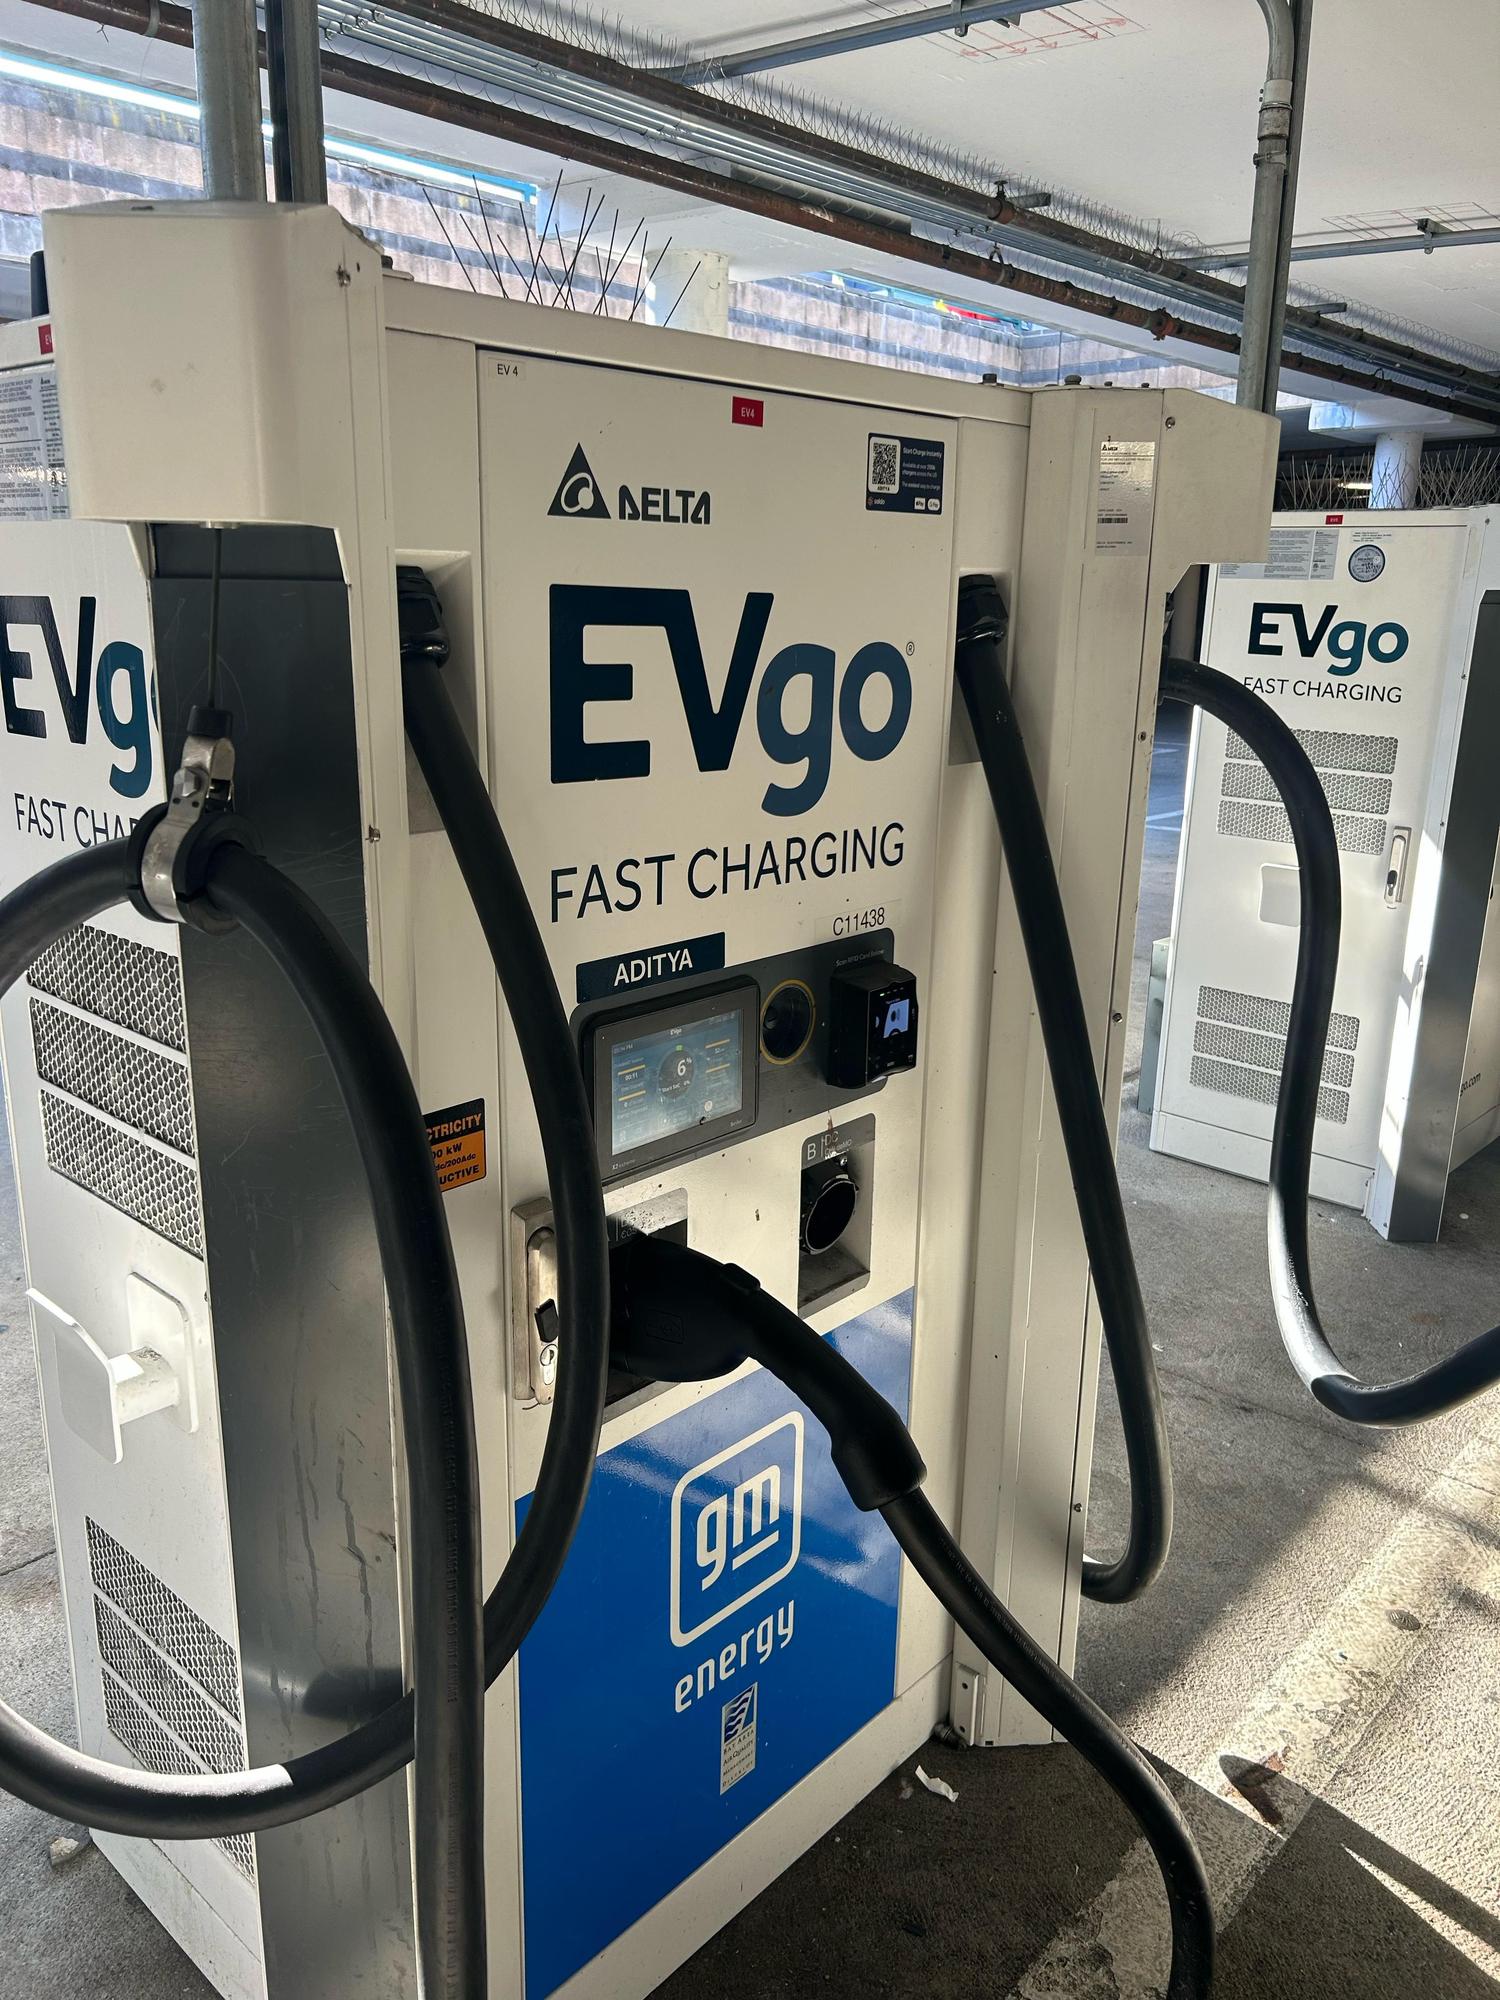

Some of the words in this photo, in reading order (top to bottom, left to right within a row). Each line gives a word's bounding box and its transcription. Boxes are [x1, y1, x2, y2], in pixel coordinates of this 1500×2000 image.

[497, 364, 511, 375] EV
[512, 366, 518, 376] 4
[741, 407, 755, 418] EV4
[913, 448, 926, 457] Charge
[926, 450, 943, 459] Instantly
[619, 484, 710, 525] DELTA
[1248, 602, 1409, 676] EVgo
[0, 596, 159, 798] EVg
[550, 584, 912, 816] EVgo
[1293, 680, 1402, 703] CHARGING
[14, 793, 67, 842] FAST
[74, 806, 142, 848] CHA
[551, 854, 675, 922] FAST
[688, 822, 904, 899] CHARGING
[832, 907, 886, 936] C11438
[614, 949, 693, 986] ADITYA
[434, 1153, 477, 1171] dc/200Adc
[446, 1143, 463, 1155] kW
[807, 1143, 817, 1161] B
[439, 1165, 480, 1185] UCTIVE
[697, 1465, 780, 1592] gm
[675, 1600, 795, 1714] energy
